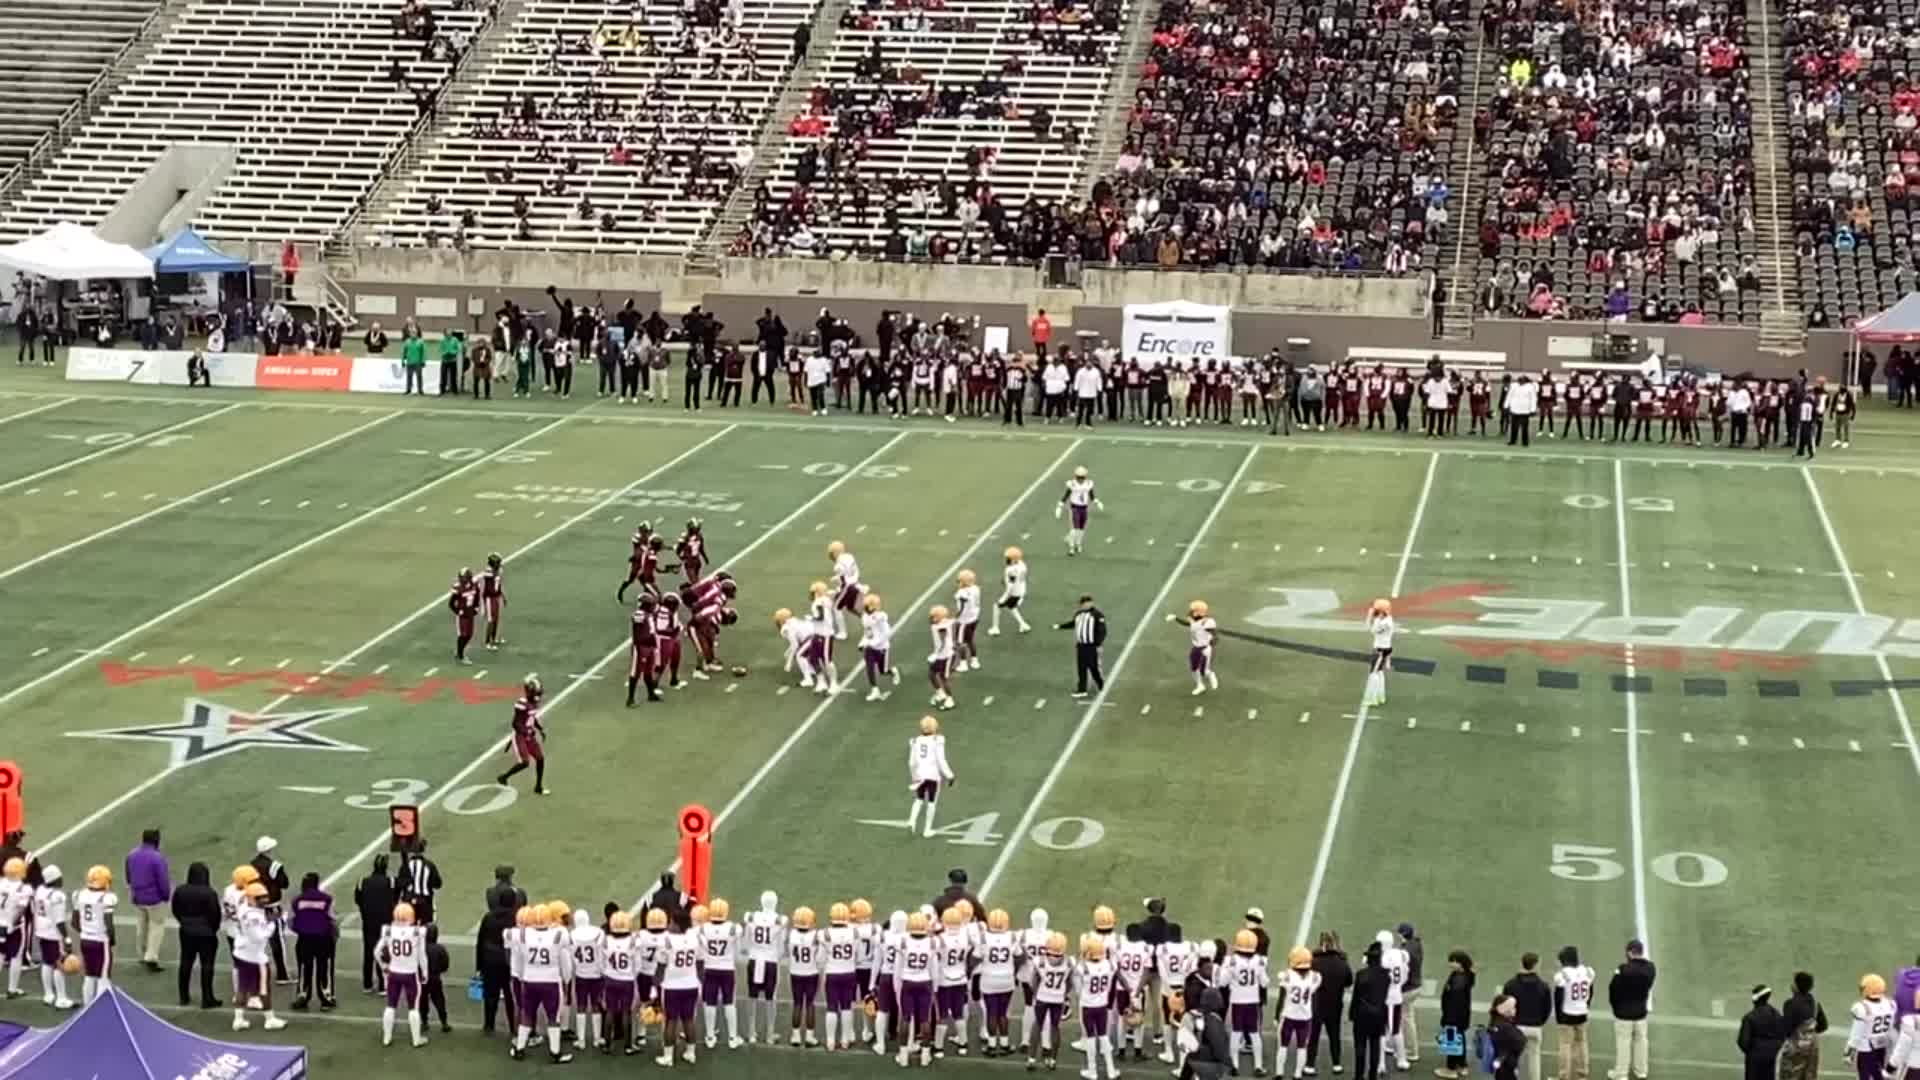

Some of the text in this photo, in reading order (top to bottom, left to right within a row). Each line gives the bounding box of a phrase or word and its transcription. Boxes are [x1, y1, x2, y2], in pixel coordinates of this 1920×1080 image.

[1137, 332, 1214, 355] Encore
[127, 361, 145, 380] 7
[1243, 586, 1920, 658] UPER
[344, 777, 518, 814] 30
[393, 809, 415, 835] 3
[1549, 843, 1728, 887] 50
[754, 925, 771, 943] 81
[392, 939, 413, 957] 80
[529, 947, 550, 964] 79
[574, 945, 594, 963] 43
[793, 945, 811, 963] 48
[832, 942, 853, 960] 69
[947, 948, 965, 966] 64
[988, 945, 1010, 963] 63
[608, 952, 628, 969] 46
[675, 950, 695, 967] 66
[908, 952, 929, 969] 29
[1121, 953, 1141, 972] 38
[1046, 972, 1065, 989] 37
[1238, 969, 1256, 986] 31
[1291, 986, 1310, 1004] 34
[1572, 981, 1588, 1000] 86
[1872, 1014, 1891, 1034] 25
